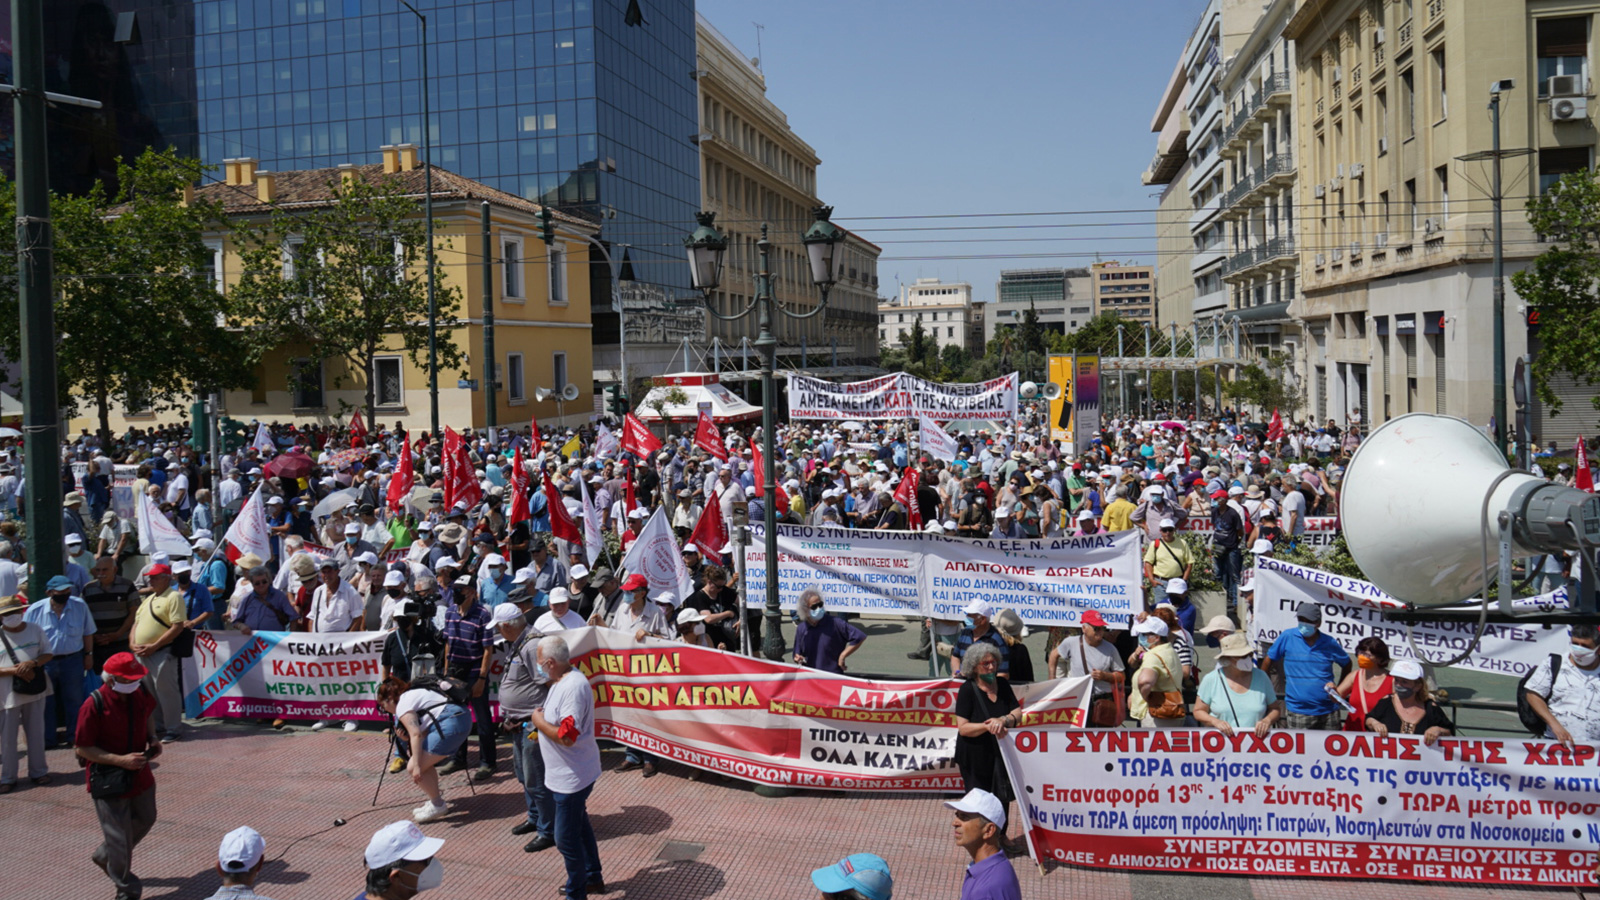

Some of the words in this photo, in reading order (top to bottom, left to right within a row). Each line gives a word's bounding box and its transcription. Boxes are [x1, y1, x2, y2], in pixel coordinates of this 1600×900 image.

[791, 376, 843, 393] ΓΕΝΝΑΙΕΣ
[846, 376, 897, 394] ΑΥΞΗΣΕΙΣ
[901, 375, 920, 390] ΣΤΙΣ
[924, 380, 981, 396] ΣΥΝΤΑΞΕΙΣ
[985, 377, 1012, 392] ΤΩΡΑ
[800, 393, 838, 409] ΑΜΕΣΑ
[842, 394, 880, 410] ΜΕΤΡΑ
[884, 392, 912, 408] ΚΑΤΑ
[916, 393, 936, 409] ΤΗΣ
[940, 393, 1004, 410] ΑΚΡΙΒΕΙΑΣ
[791, 410, 838, 418] ΣΩΜΑΤΕΙΑ
[842, 410, 912, 418] ΣΥΝΤΑΞΙΟΥΧΩΝ
[914, 410, 1012, 419] ΑΤΩΛΟΑΚΑΡΝΑΝΙΑΣ
[748, 524, 813, 537] ΣΩΑΤΕΙΟ
[818, 527, 923, 541] ΣΥΝΤΑΞΙΟΥΧΩΝ
[1030, 540, 1044, 550] Ν.
[1050, 534, 1116, 550] ΔΡΑΜΑΣ
[801, 542, 852, 550] ΣΥΝΤΑΞΕΙΣ
[810, 556, 835, 566] ΜΕΙΩΣΗ
[838, 557, 852, 566] ΣΤΙΣ
[854, 558, 890, 568] ΣΥΝΤΑΞΕΙΣ
[892, 558, 909, 568] ΜΑΣ
[944, 562, 1036, 576] ΑΠΑΙΤΟΥΜΕ
[1046, 567, 1113, 578] ΔΩΡΕΑΝ
[814, 570, 840, 580] ΟΛΩΝ
[842, 572, 861, 582] ΤΩΝ
[864, 574, 916, 584] ΠΕΡΙΚΟΠΩΝ
[1258, 558, 1343, 588] ΣΩΜΑΤΕΙΟ
[822, 583, 882, 595] ΧΡΙΣΤΟΥΓΕΝΝΩΝ
[892, 588, 918, 598] ΠΑΣΧΑ
[934, 576, 971, 588] ΕΝΙΑΙΟ
[974, 578, 1025, 591] ΔΗΜΟΣΙΟ
[1028, 582, 1084, 594] ΣΥΣΤΗΜΑ
[1086, 584, 1126, 595] ΥΓΕΙΑΣ
[824, 597, 849, 607] ΗΛΙΚΙΑΣ
[851, 598, 861, 607] ΓΙΑ
[864, 598, 920, 610] ΣΥΝΤΑΞΙΟΔΟΤΗΣΗ
[932, 590, 948, 600] ΚΑΙ
[953, 592, 1066, 606] ΙΑΤΡΟΦΑΡΜΑΚΕΥΤΙΚΗ
[1070, 598, 1130, 610] ΠΕΡΙΘΑΛΨΗ
[1325, 620, 1364, 637] ΤΩΝ
[1372, 626, 1481, 653] ΒΡΥΞΕΛΩΝ
[288, 642, 346, 656] ΓΕΝΑΙΑ
[352, 640, 384, 654] ΑΥΞ
[198, 636, 269, 706] ΑΠΑΙΤΟΥΜΕ
[272, 658, 380, 678] ΚΑΤΩΤΕΡΗ
[573, 654, 625, 677] ΑΝΕΙ
[630, 652, 680, 674] ΠΙΑ!
[1480, 657, 1535, 674] ΖΗΣΟΥ
[265, 682, 316, 696] ΜΕΤΡΑ
[318, 681, 376, 696] ΠΡΟΣΤ
[610, 684, 669, 706] ΣΤΟΝ
[675, 685, 760, 706] ΑΓΩΝΑ
[227, 701, 284, 716] Σωματείο
[286, 703, 374, 717] Συνταξιούχων
[770, 700, 828, 717] ΜΕΤΡΑ
[832, 708, 946, 726] ΠΡΟΣΤΑΣΙΑΣ
[1042, 709, 1080, 724] ΜΑΣ
[809, 728, 870, 744] ΤΙΠΟΤΑ
[874, 734, 908, 747] ΔΕΝ
[912, 736, 948, 750] ΜΑΣ
[1015, 731, 1048, 754] ΟΙ
[1066, 731, 1305, 755] ΣΥΝΤΑΞΙΟΥΧΟΙ
[1324, 734, 1421, 760] ΟΛΗΣ
[1438, 738, 1507, 764] ΤΗΣ
[1524, 742, 1600, 766] ΧΩΡ
[601, 724, 670, 754] ΣΩΜΑΤΕΙΟ
[673, 750, 793, 782] ΣΥΝΤΑΞΙΟΥΧΩΝ
[797, 773, 826, 787] ΙΚΑ
[831, 774, 965, 790] ΑΘΗΝΑΣ-ΓΑΛΑΤ
[811, 746, 858, 766] ΟΛΑ
[1118, 758, 1174, 778] ΤΩΡΑ
[1180, 757, 1271, 782] αυξήσεις
[1278, 764, 1303, 779] σε
[1310, 760, 1359, 786] όλες
[1366, 768, 1397, 788] τις
[1404, 766, 1512, 792] συντάξεις
[1518, 776, 1546, 792] με
[1042, 784, 1160, 808] Επαναφορά
[1167, 782, 1203, 804] 13ης
[1220, 782, 1257, 804] 14ης
[1263, 784, 1362, 814] Σύνταξης
[1399, 792, 1461, 813] ΤΩΡΑ
[1468, 794, 1532, 820] μέτρα
[1538, 800, 1600, 820] προσ
[1029, 804, 1048, 823] Να
[1052, 808, 1084, 830] γίνει
[1088, 810, 1128, 830] ΤΩΡΑ
[1133, 810, 1177, 834] άμεση
[1181, 811, 1262, 836] πρόσληψη:
[1266, 812, 1330, 838] Γιατρών,
[1336, 815, 1432, 840] Νοσηλευτών
[1437, 824, 1466, 840] στα
[1470, 822, 1565, 846] Νοσοκομεία
[1164, 840, 1358, 858] ΣΥΝΕΡΓΑΖΟΜΕΝΕΣ
[1368, 844, 1558, 866] ΣΥΝΤΑΞΙΟΥΧΙΚΕΣ
[1054, 848, 1095, 864] ΟΑΕΕ
[1108, 854, 1192, 870] ΔΗΜΟΣΙΟΥ
[1206, 857, 1248, 872] ΠΟΣΕ
[1253, 858, 1296, 872] ΟΑΕΕ
[1310, 860, 1351, 874] ΕΛΤΑ
[1365, 862, 1398, 876] ΟΣΕ
[1413, 864, 1446, 878] ΠΕΣ
[1450, 866, 1484, 878] ΝΑΤ
[1500, 866, 1536, 880] ΠΣΣ
